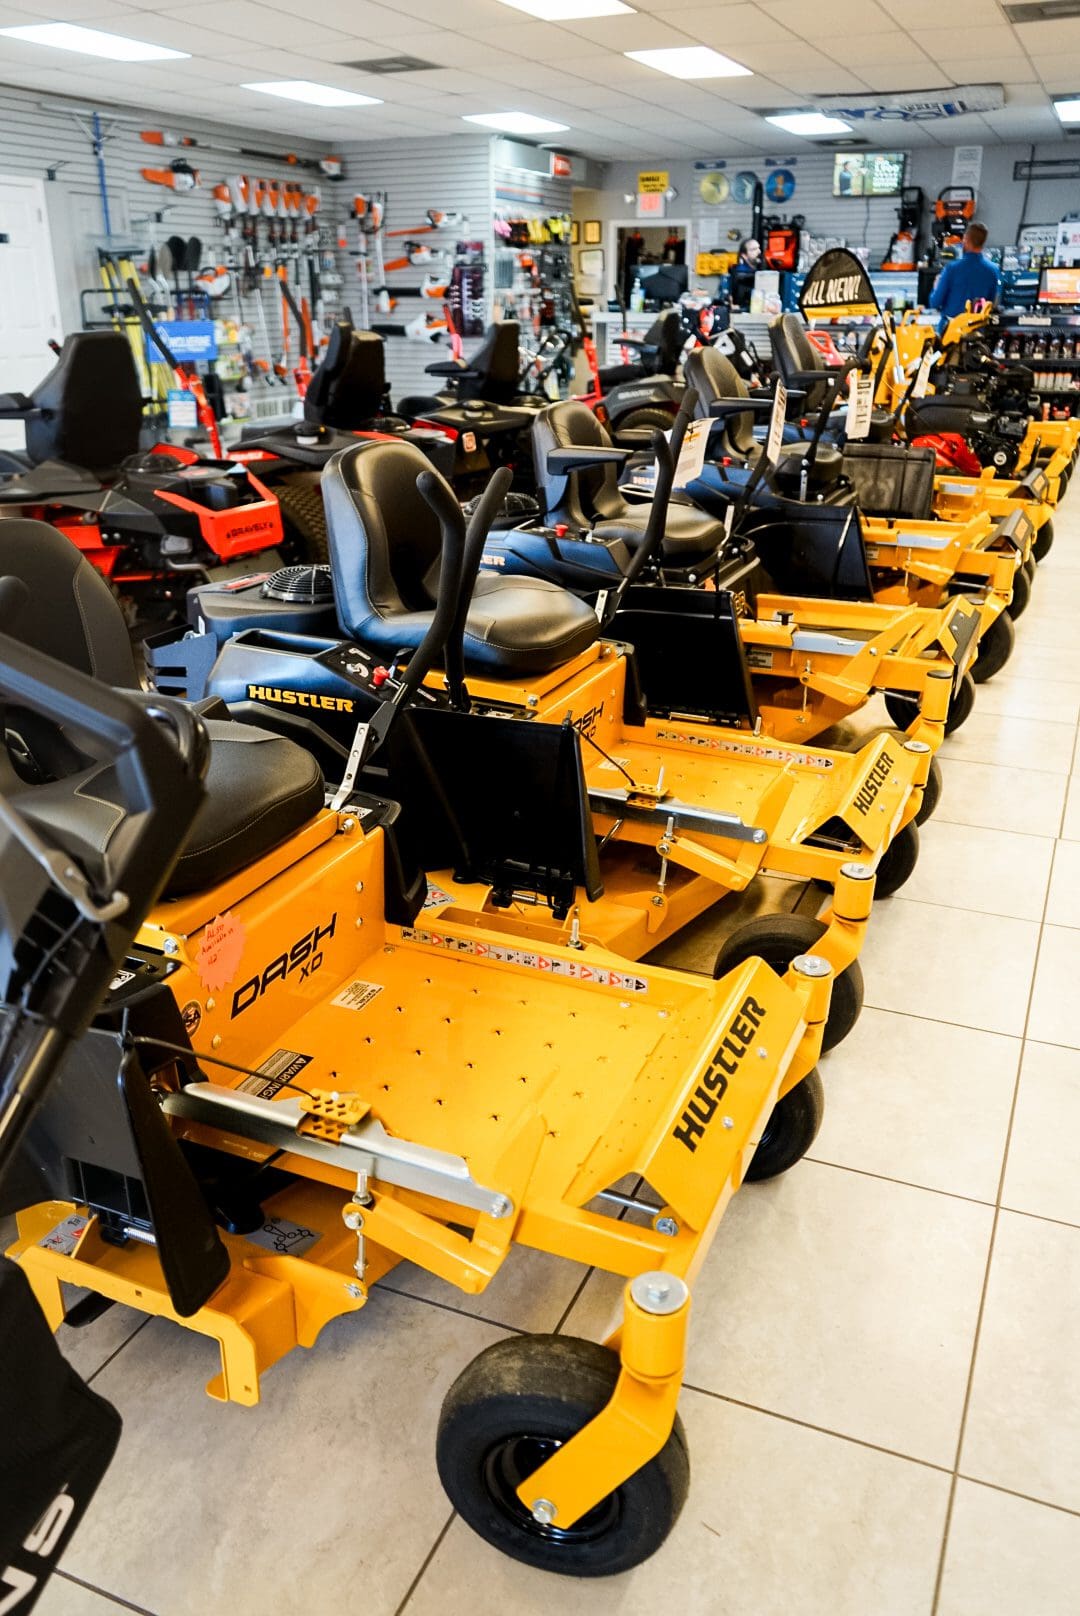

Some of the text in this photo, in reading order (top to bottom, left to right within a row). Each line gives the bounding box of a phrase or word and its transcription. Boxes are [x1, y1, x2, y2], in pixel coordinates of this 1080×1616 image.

[802, 275, 861, 305] ALL NEW!
[231, 523, 268, 537] GRAVELY
[249, 685, 354, 713] HUSTLER
[572, 701, 605, 731] ASH
[853, 751, 894, 817] HUSTLER
[231, 912, 337, 1020] DASH
[299, 951, 323, 984] XD
[672, 996, 767, 1154] HUSTLER
